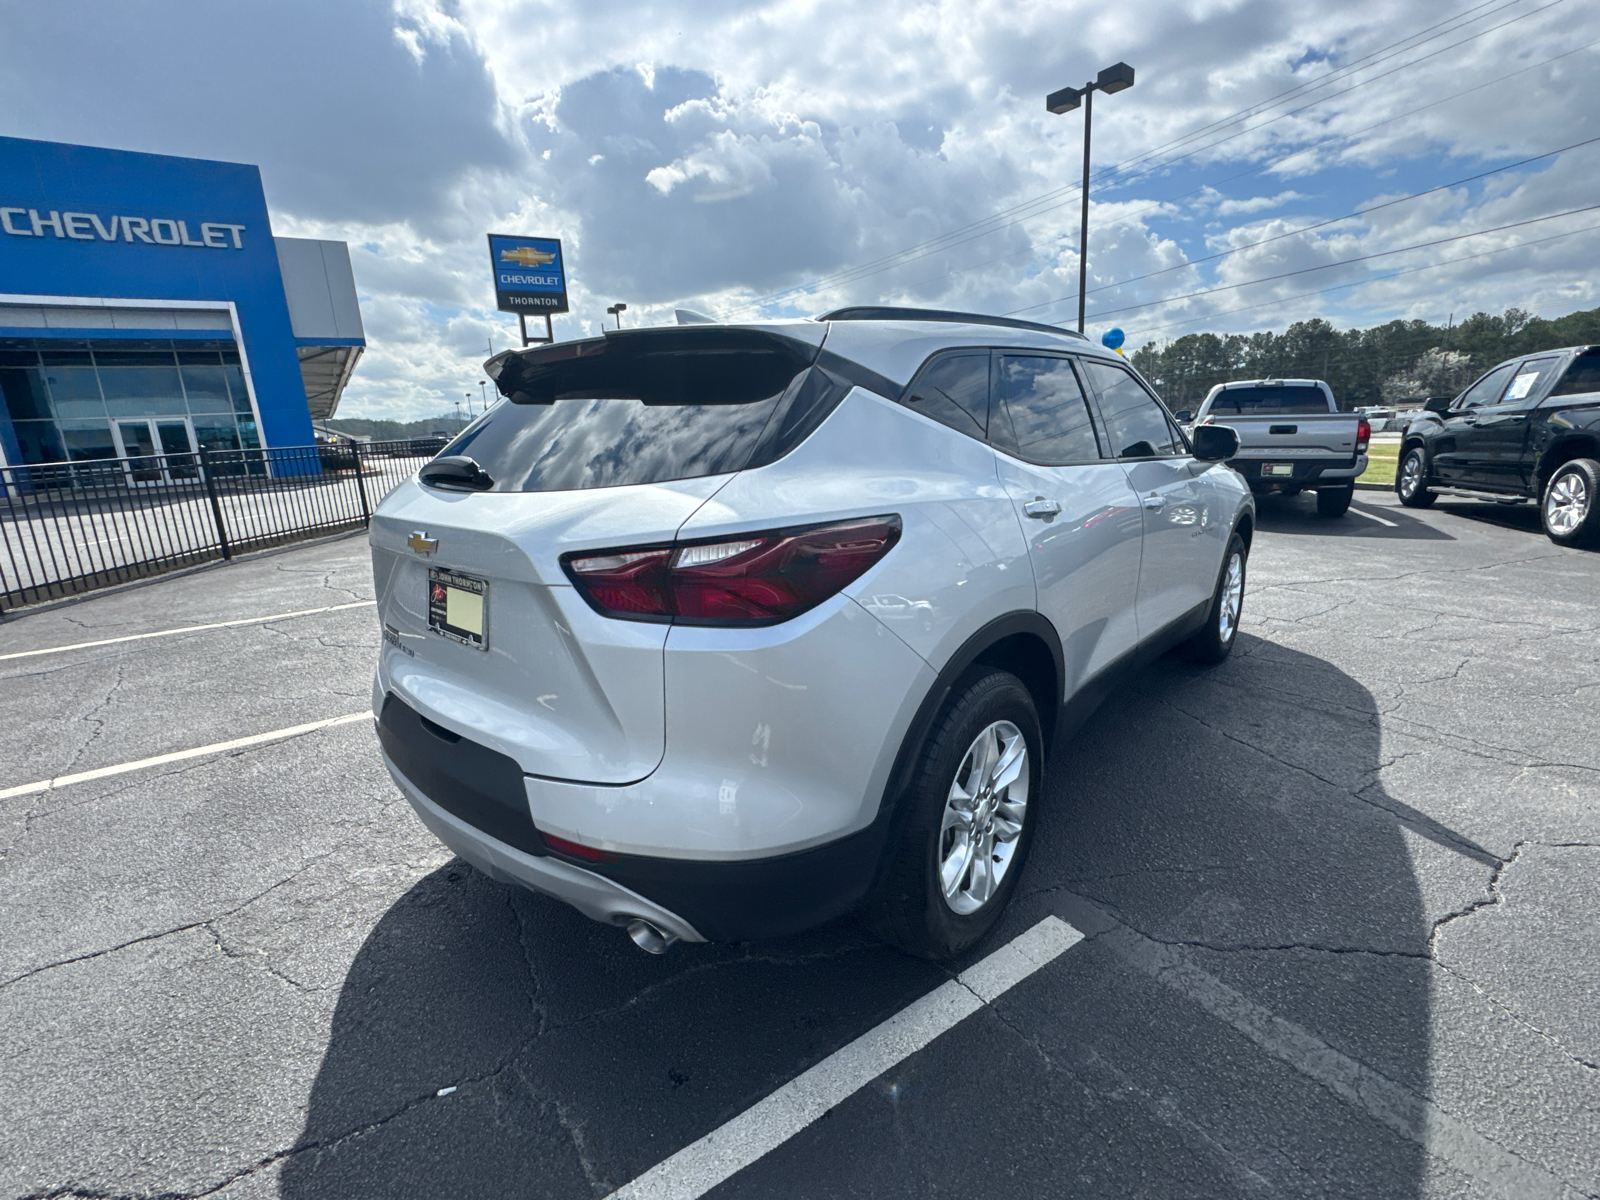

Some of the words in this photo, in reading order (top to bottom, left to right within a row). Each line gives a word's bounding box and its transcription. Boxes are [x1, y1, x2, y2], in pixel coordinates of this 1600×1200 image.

[0, 207, 246, 249] CHEVROLET
[501, 275, 558, 285] CHEVROLET
[509, 297, 558, 306] THORNTON
